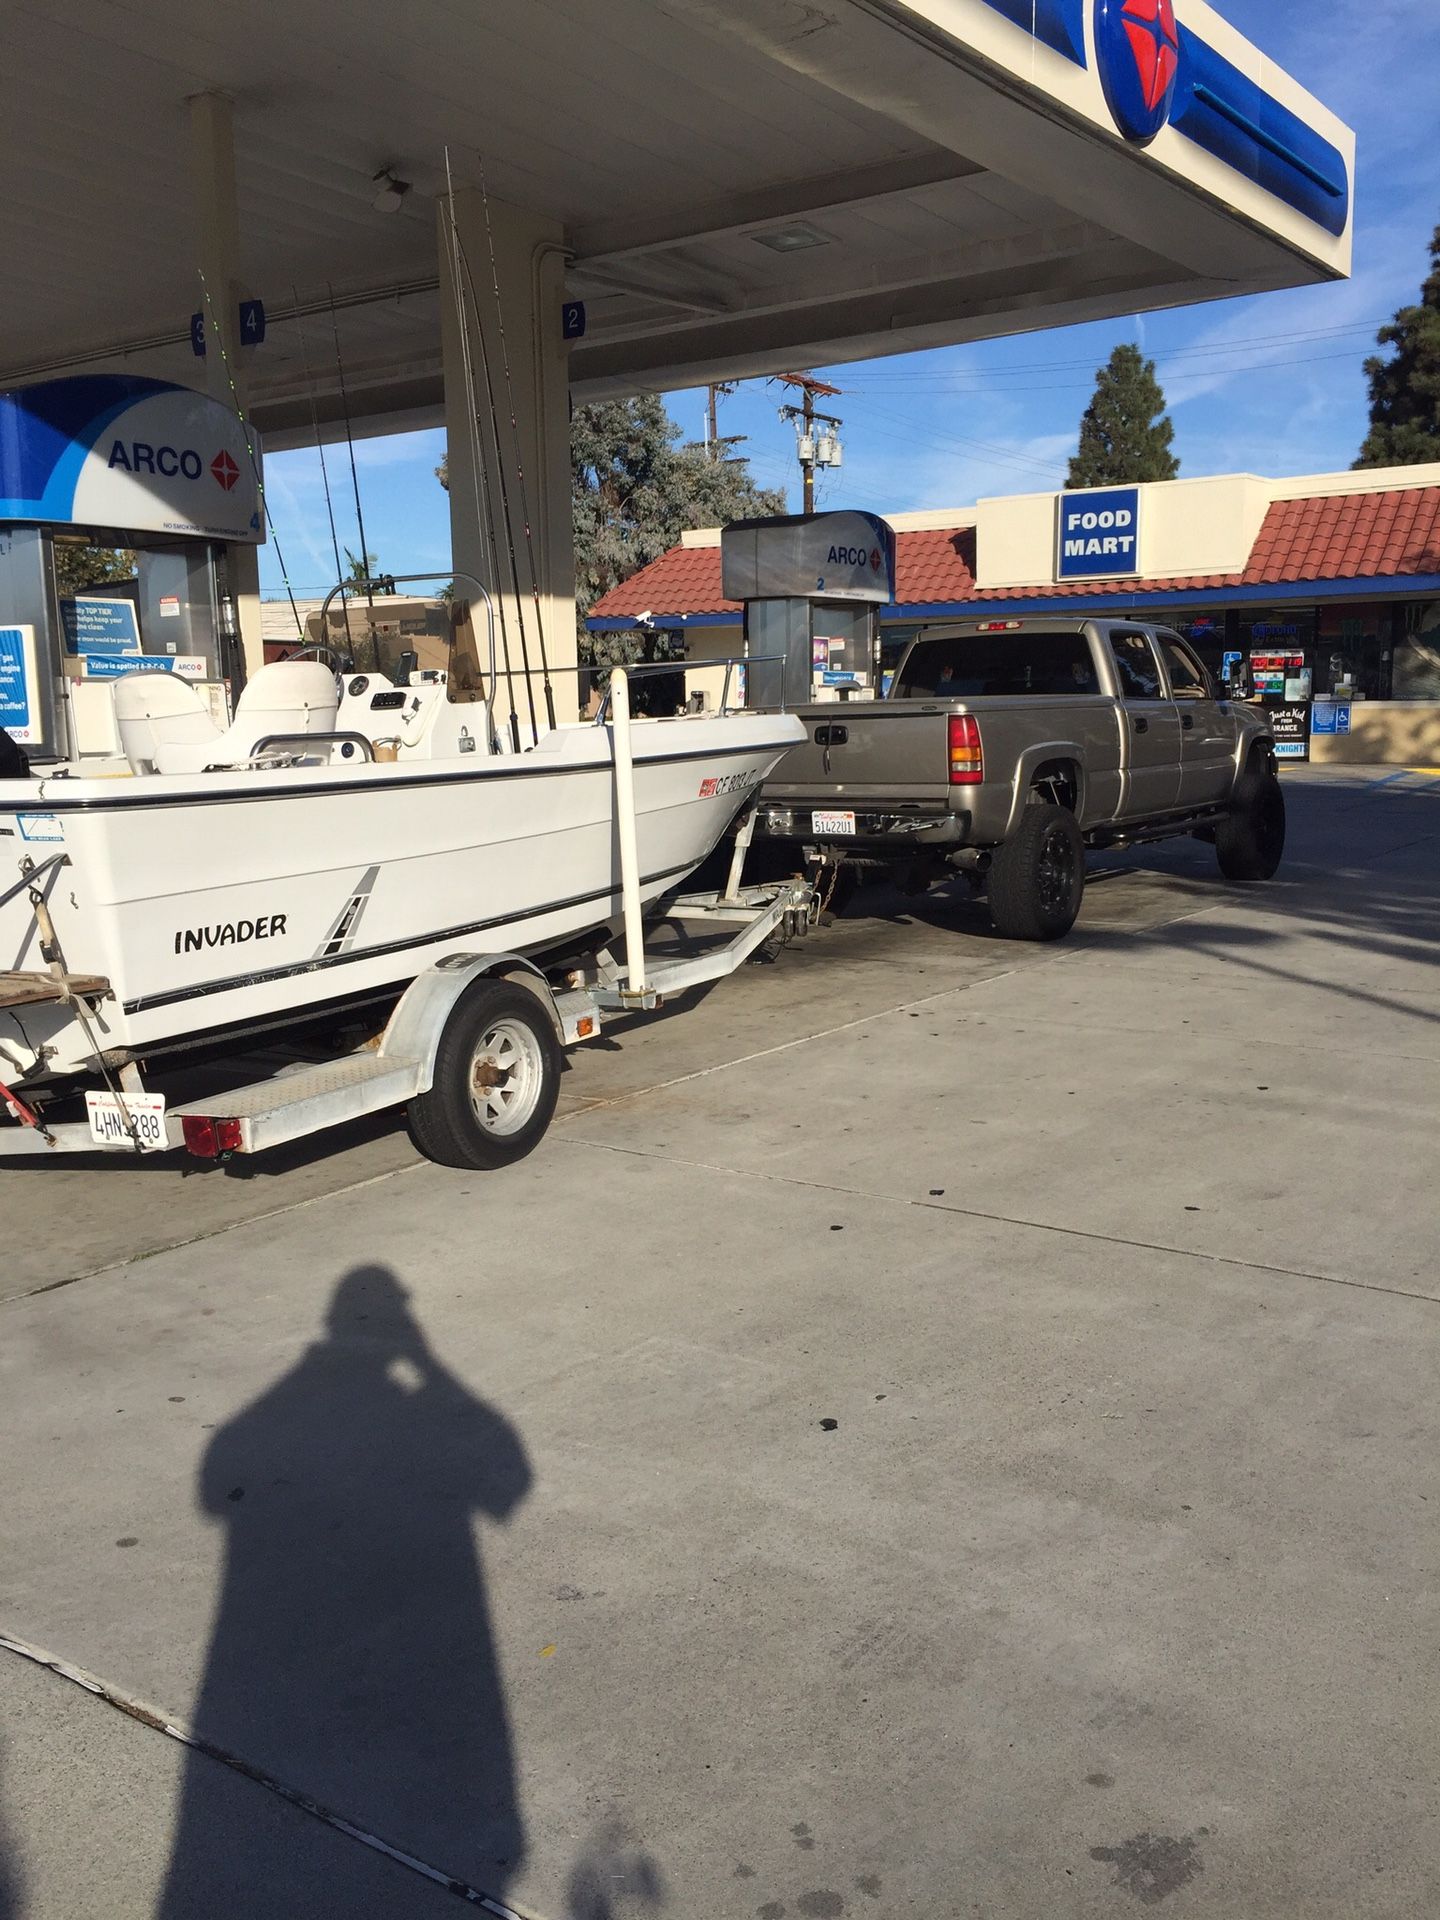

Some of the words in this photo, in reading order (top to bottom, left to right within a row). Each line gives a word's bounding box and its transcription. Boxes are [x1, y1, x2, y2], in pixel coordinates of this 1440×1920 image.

[246, 309, 256, 331] 4
[567, 308, 579, 328] 2
[196, 320, 204, 343] 3
[108, 440, 202, 480] ARCO
[250, 512, 260, 532] 4
[1068, 509, 1131, 531] FOOD
[1065, 535, 1134, 557] MART
[828, 546, 866, 567] ARCO
[817, 578, 824, 591] 2
[90, 662, 109, 670] Value
[117, 662, 140, 671] spelled
[4, 702, 26, 711] coffee?
[1269, 710, 1285, 722] Just
[1292, 708, 1305, 722] Kid
[715, 776, 730, 794] CF
[815, 821, 852, 833] 51422U1
[175, 914, 287, 955] INVADER
